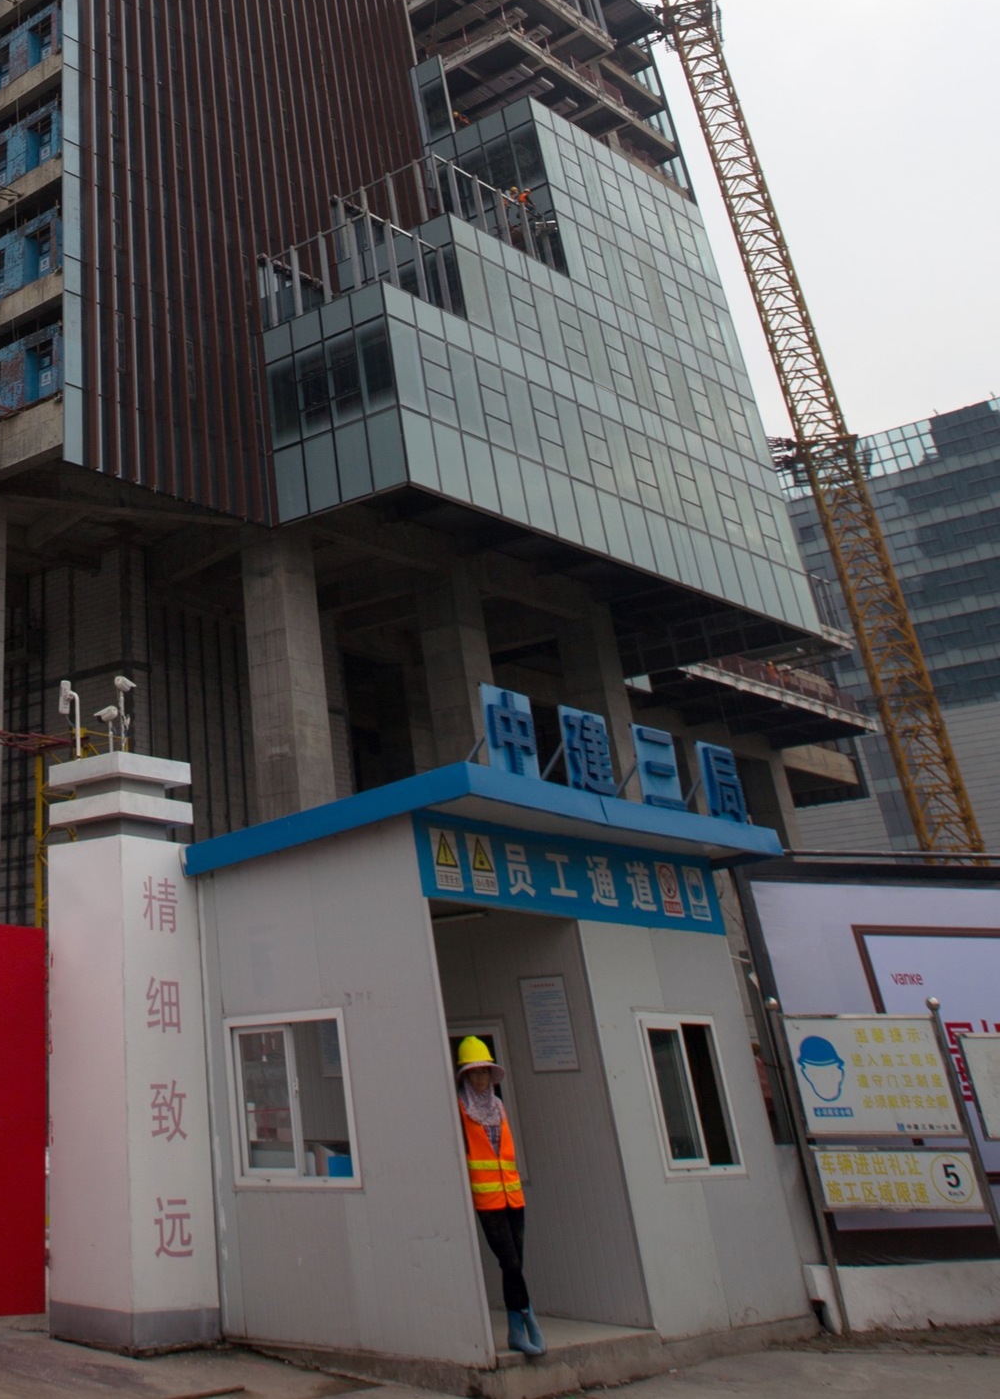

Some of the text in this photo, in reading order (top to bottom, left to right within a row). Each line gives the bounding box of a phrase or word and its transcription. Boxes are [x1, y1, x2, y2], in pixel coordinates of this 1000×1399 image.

[487, 690, 747, 823] 中建三局
[504, 843, 657, 912] 员工通道
[890, 973, 924, 986] vanke
[854, 1027, 921, 1044] 温馨提示
[142, 875, 194, 1258] 精细致远
[851, 1053, 938, 1067] 进入施工现场
[857, 1073, 945, 1088] 遵守门卫制度
[862, 1094, 949, 1109] 必须戴好安全帽
[819, 1154, 922, 1175] 车辆进出礼让
[942, 1163, 961, 1188] 5
[826, 1181, 931, 1203] 施工区域限速
